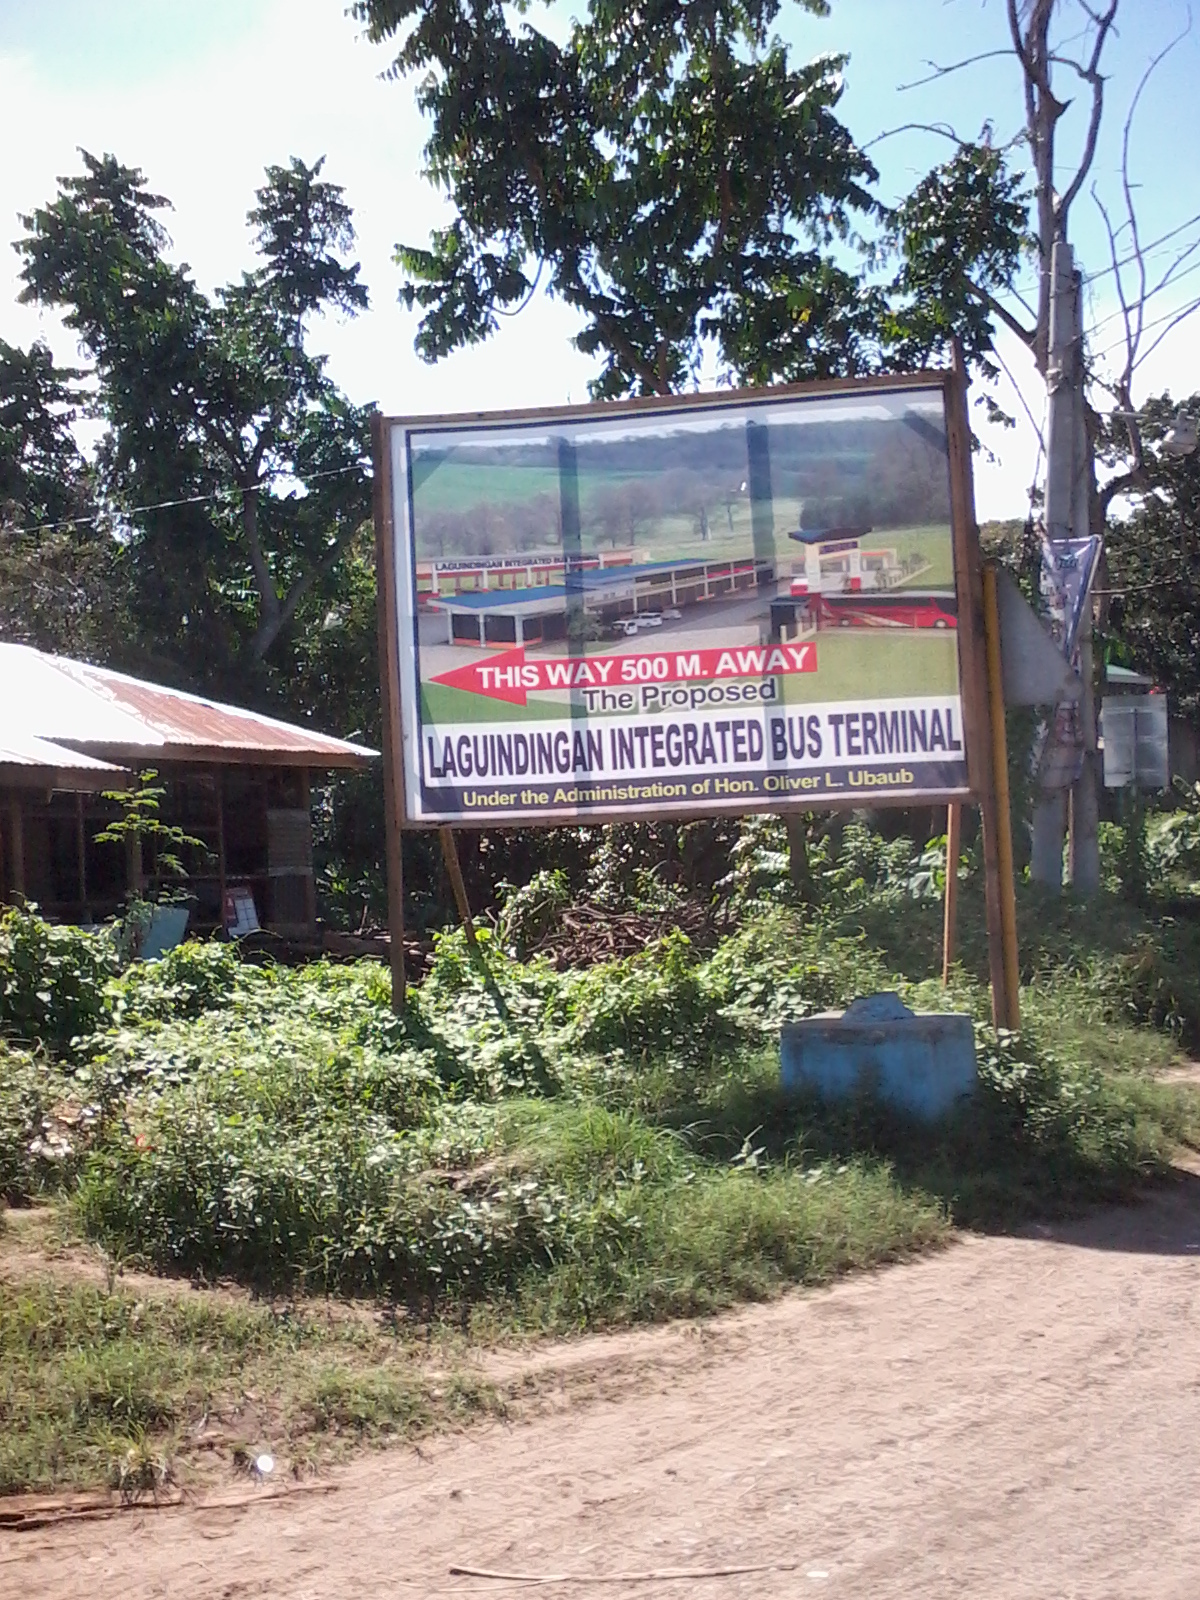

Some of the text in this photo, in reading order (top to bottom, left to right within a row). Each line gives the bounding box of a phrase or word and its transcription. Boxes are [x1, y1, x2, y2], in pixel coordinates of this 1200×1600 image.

[476, 646, 810, 689] THIS WAY 500 M. AWAY
[582, 678, 776, 711] The Proposed
[428, 708, 962, 778] LAGUINDINGAN INTEGRATED BUS TERMINAL
[463, 768, 914, 807] Under the Administration of Hon. Oliver L. Ubaub
